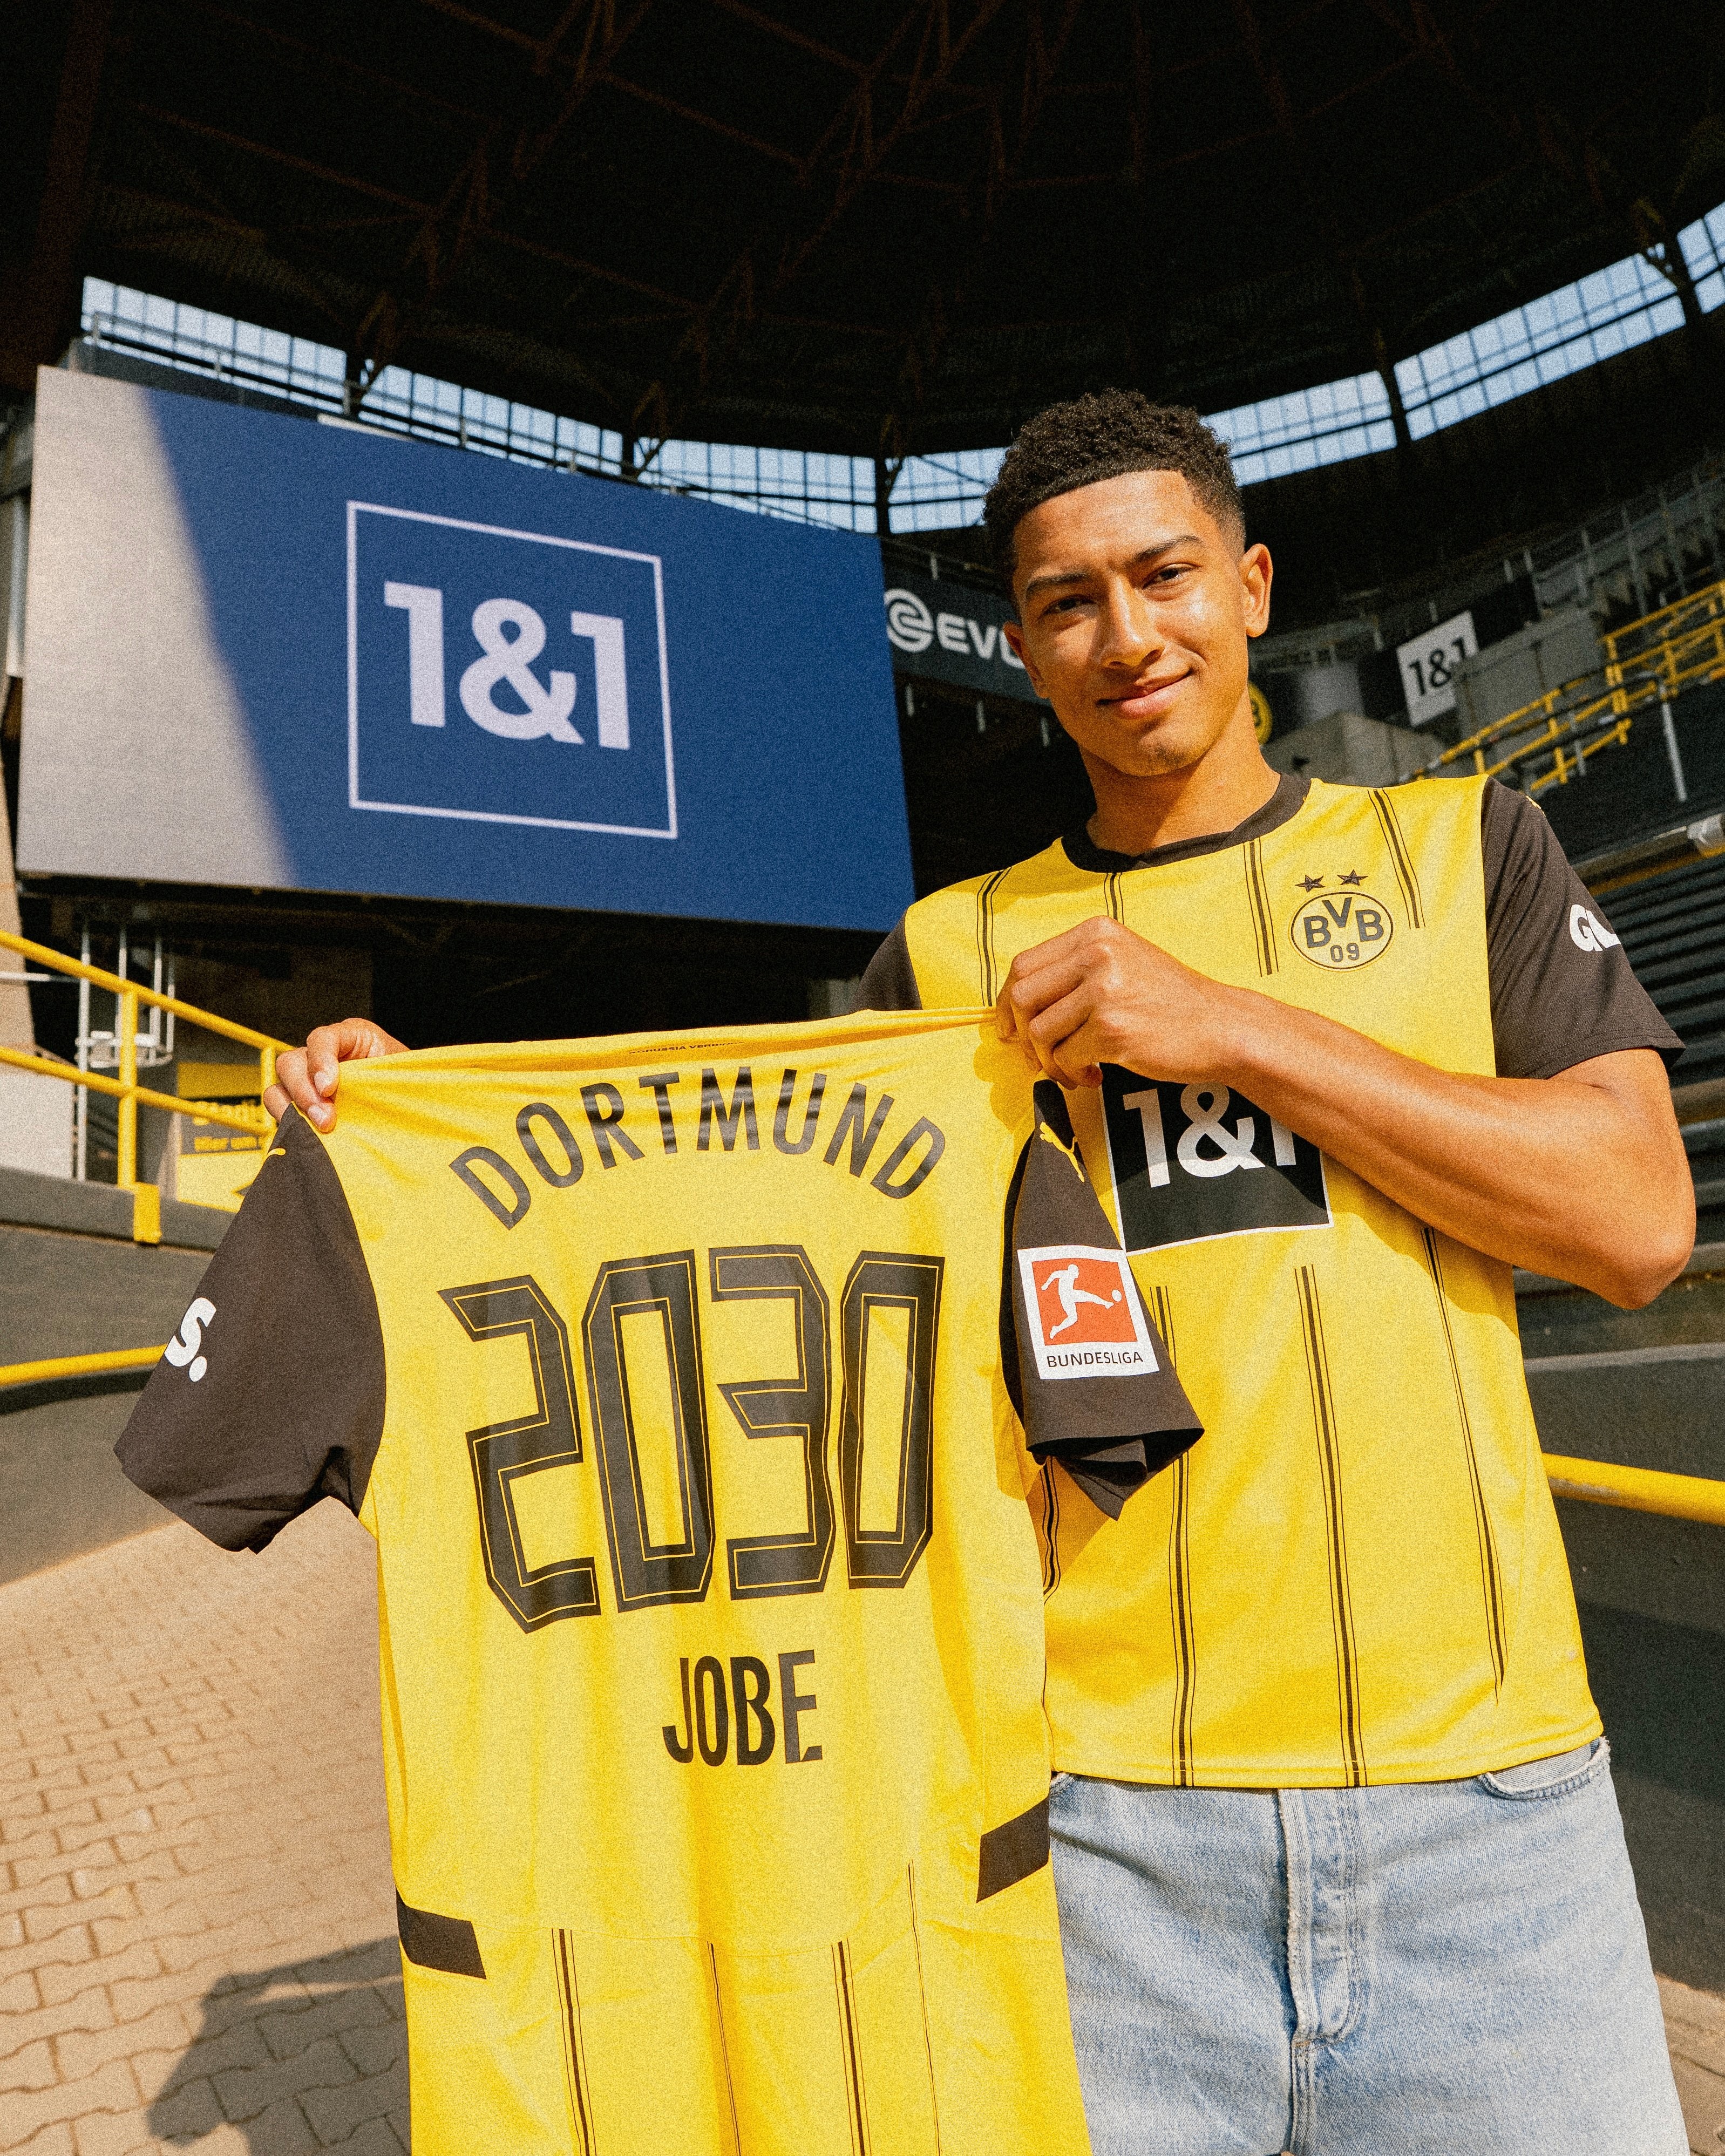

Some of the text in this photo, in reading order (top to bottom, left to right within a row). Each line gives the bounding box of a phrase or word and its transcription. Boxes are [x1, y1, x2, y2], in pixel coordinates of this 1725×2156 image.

[384, 580, 630, 750] 1&1
[1408, 636, 1466, 696] 1&1
[1303, 897, 1384, 948] BVB
[1330, 942, 1360, 963] 09
[450, 1066, 946, 1230] DORTMUND
[1047, 1351, 1144, 1368] BUNDESLIGA
[437, 1244, 945, 1634] 2030
[662, 1649, 823, 1767] JOBE
